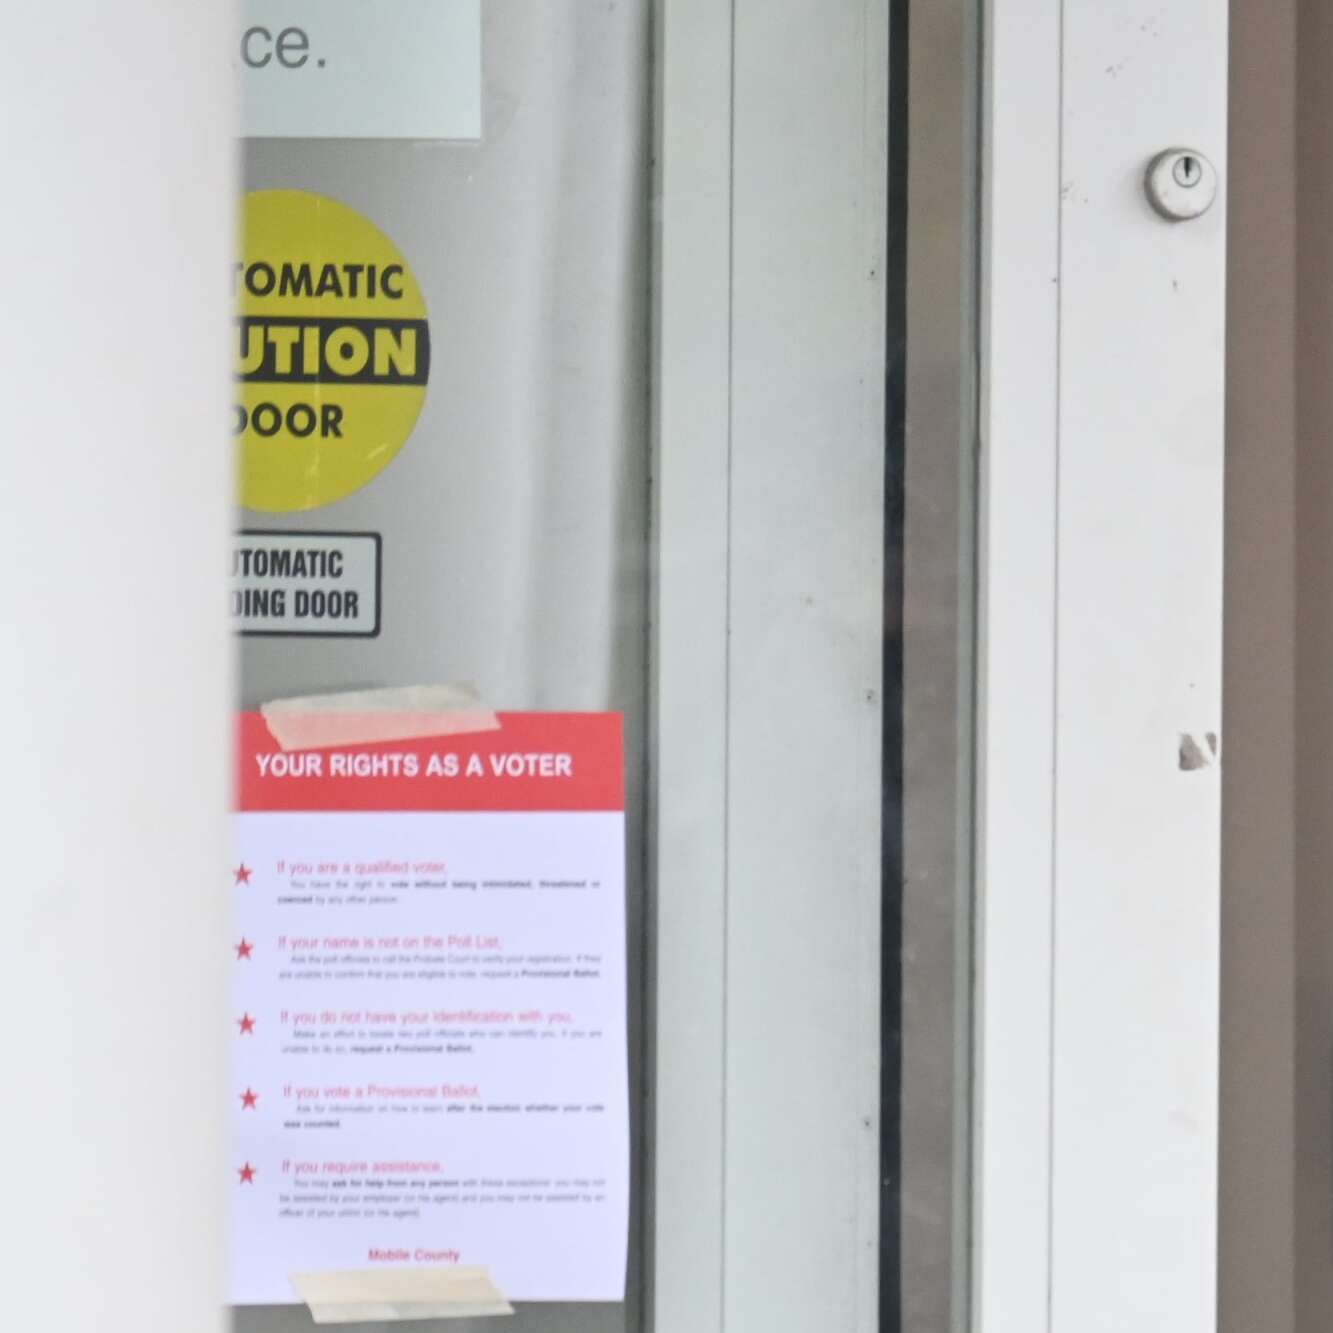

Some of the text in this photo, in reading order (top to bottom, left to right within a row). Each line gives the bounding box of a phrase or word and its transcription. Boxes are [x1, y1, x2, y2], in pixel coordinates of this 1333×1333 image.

[241, 26, 326, 69] ce.
[294, 590, 358, 619] DOOR
[255, 753, 572, 777] YOUR RIGHTS AS A VOTER
[277, 860, 286, 874] If
[288, 863, 314, 877] you
[316, 863, 338, 874] are
[354, 860, 410, 877] qualified
[278, 935, 288, 949] If
[288, 938, 318, 952] your
[322, 938, 360, 949] name
[378, 936, 400, 949] not
[402, 938, 420, 949] on
[422, 935, 444, 949] the
[448, 935, 472, 949] Poll
[280, 1010, 288, 1024] If
[292, 1013, 316, 1027] you
[320, 1010, 338, 1024] do
[340, 1011, 362, 1024] not
[364, 1010, 398, 1024] have
[400, 1013, 428, 1027] your
[432, 1010, 514, 1024] identification
[518, 1010, 544, 1024] with
[283, 1085, 292, 1098] If
[294, 1087, 320, 1101] you
[322, 1085, 352, 1098] vote
[368, 1085, 438, 1098] Provisional
[282, 1159, 292, 1173] If
[292, 1162, 318, 1176] you
[322, 1159, 368, 1176] require
[368, 1248, 460, 1265] Mobile County
